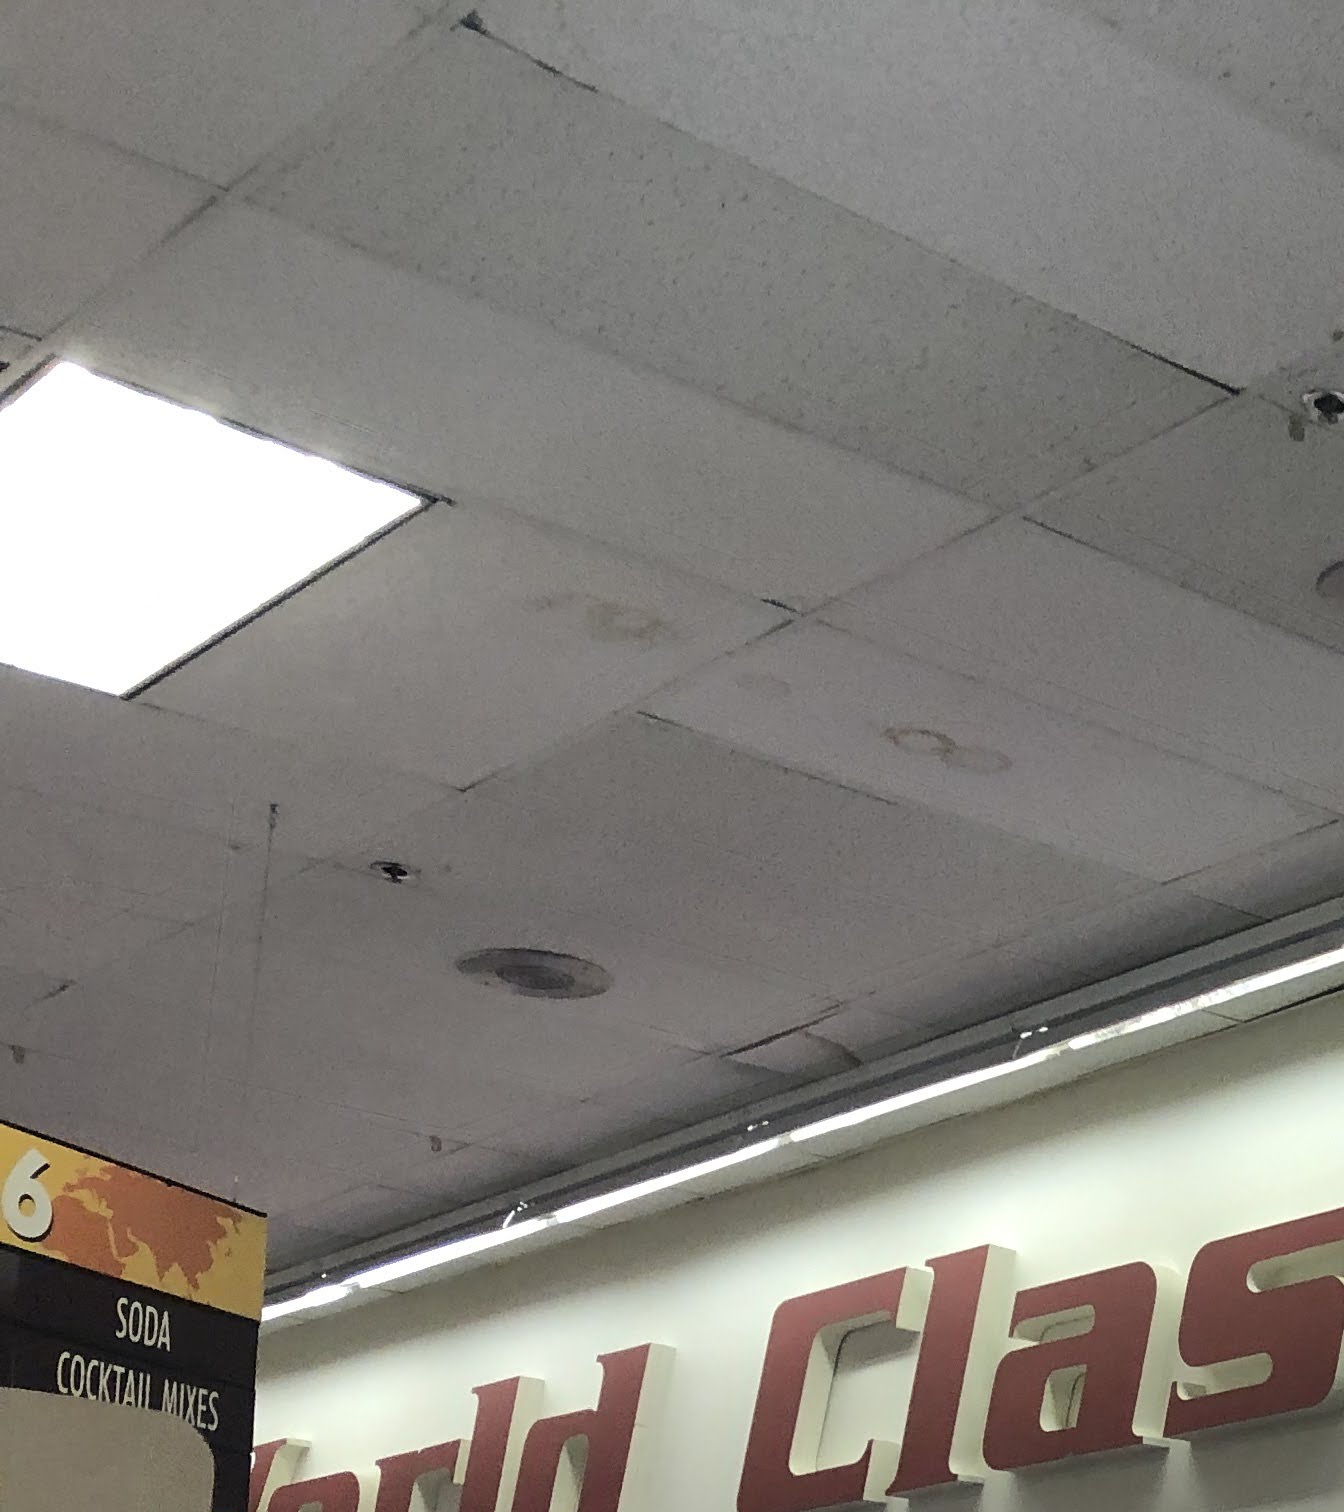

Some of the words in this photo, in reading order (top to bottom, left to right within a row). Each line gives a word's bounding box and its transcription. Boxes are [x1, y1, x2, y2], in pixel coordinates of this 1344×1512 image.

[2, 1147, 54, 1243] 6
[115, 1297, 172, 1353] SODA
[57, 1350, 151, 1408] COCKTAIL
[162, 1378, 220, 1433] MIXES
